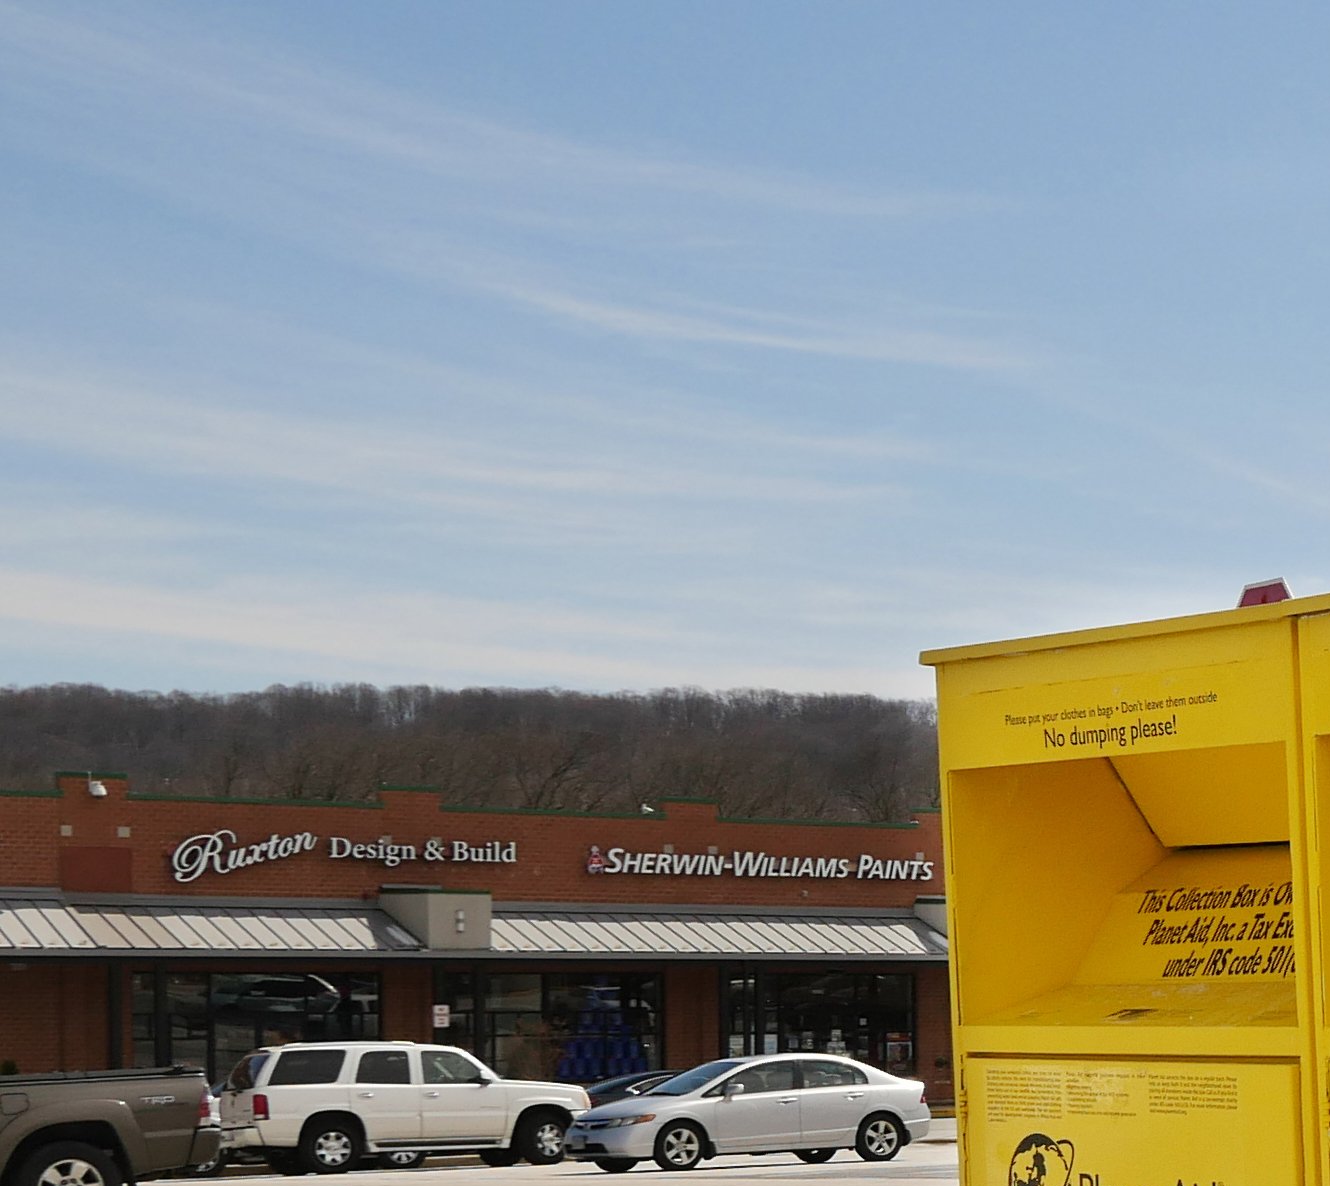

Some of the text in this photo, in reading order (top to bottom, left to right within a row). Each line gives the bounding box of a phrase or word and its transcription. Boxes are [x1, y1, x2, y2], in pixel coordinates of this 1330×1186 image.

[171, 829, 517, 883] Ruxton Design & Build
[604, 847, 935, 881] SHERWIN-WILLIAMS PAINTS
